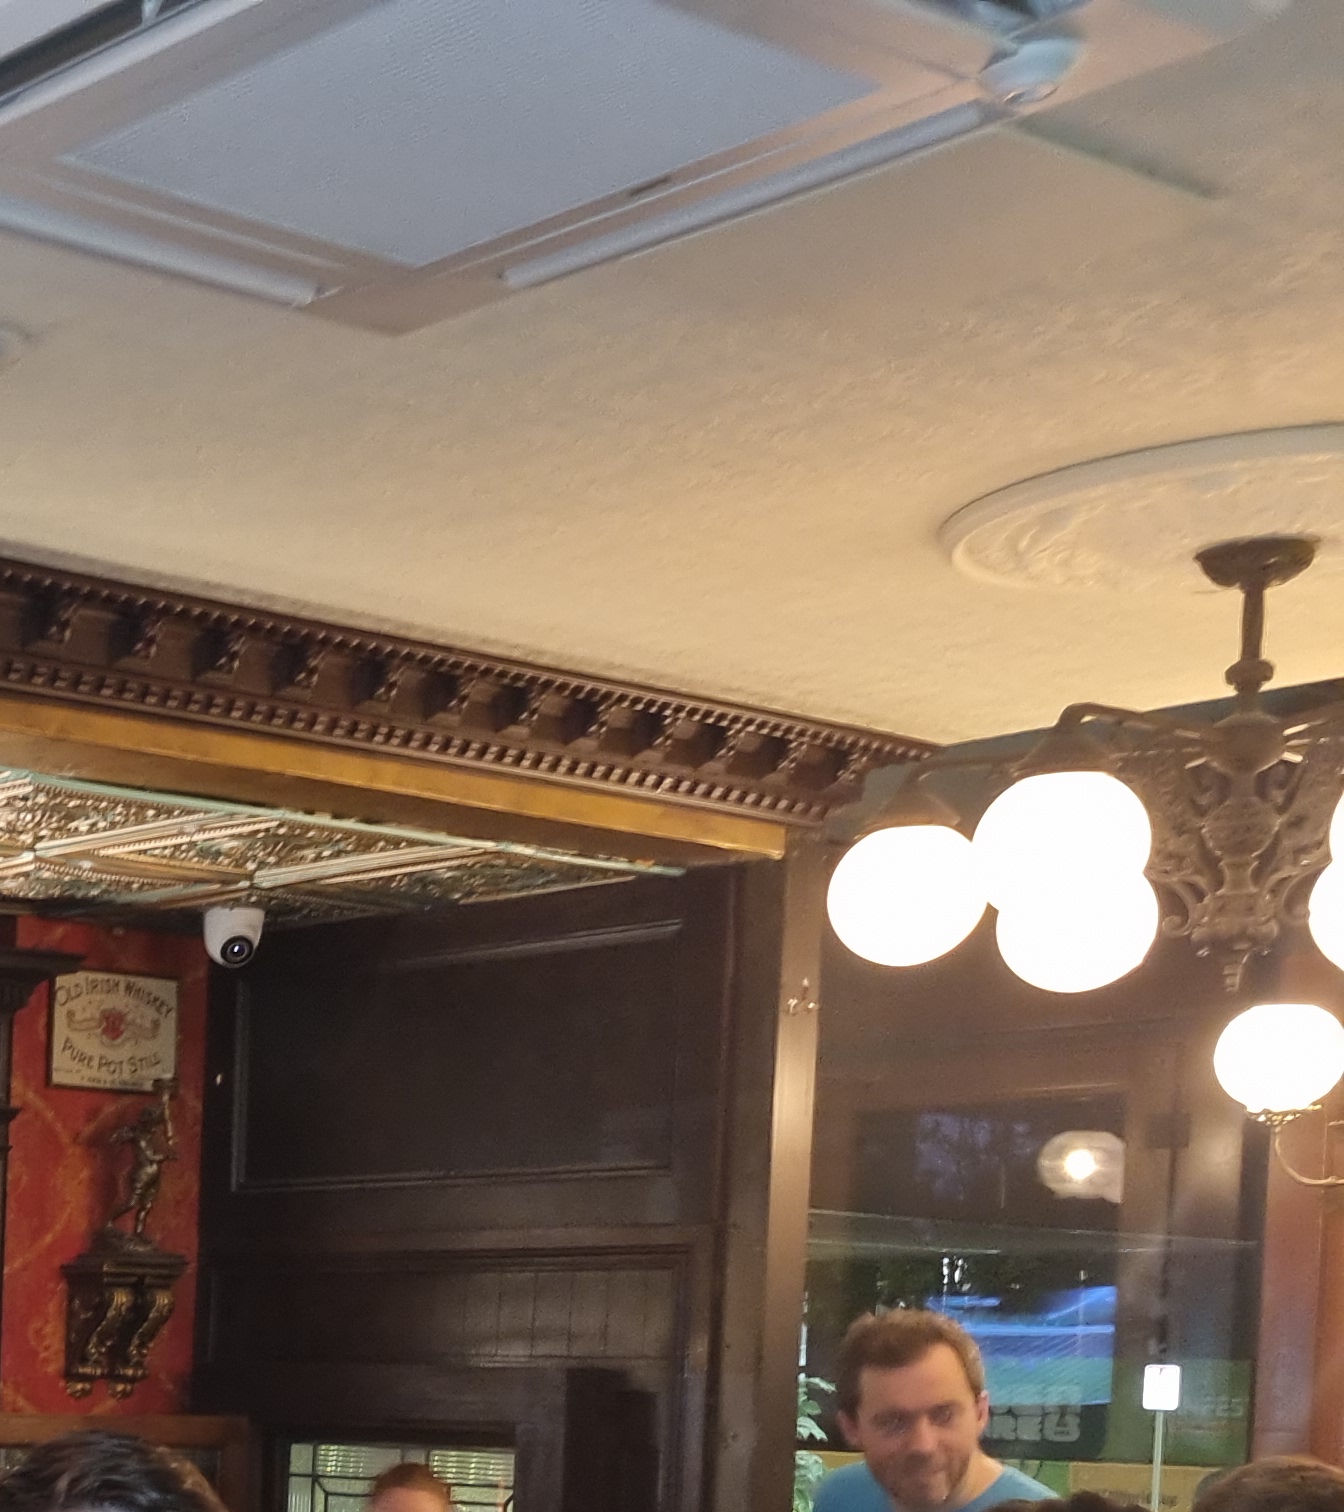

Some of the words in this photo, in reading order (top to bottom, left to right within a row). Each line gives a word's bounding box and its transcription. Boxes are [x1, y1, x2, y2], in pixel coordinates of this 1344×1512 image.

[56, 981, 83, 1007] OLD
[85, 977, 120, 996] IRISH
[124, 979, 173, 1018] WHISKEY
[61, 1036, 95, 1069] PURE
[97, 1055, 124, 1075] POT
